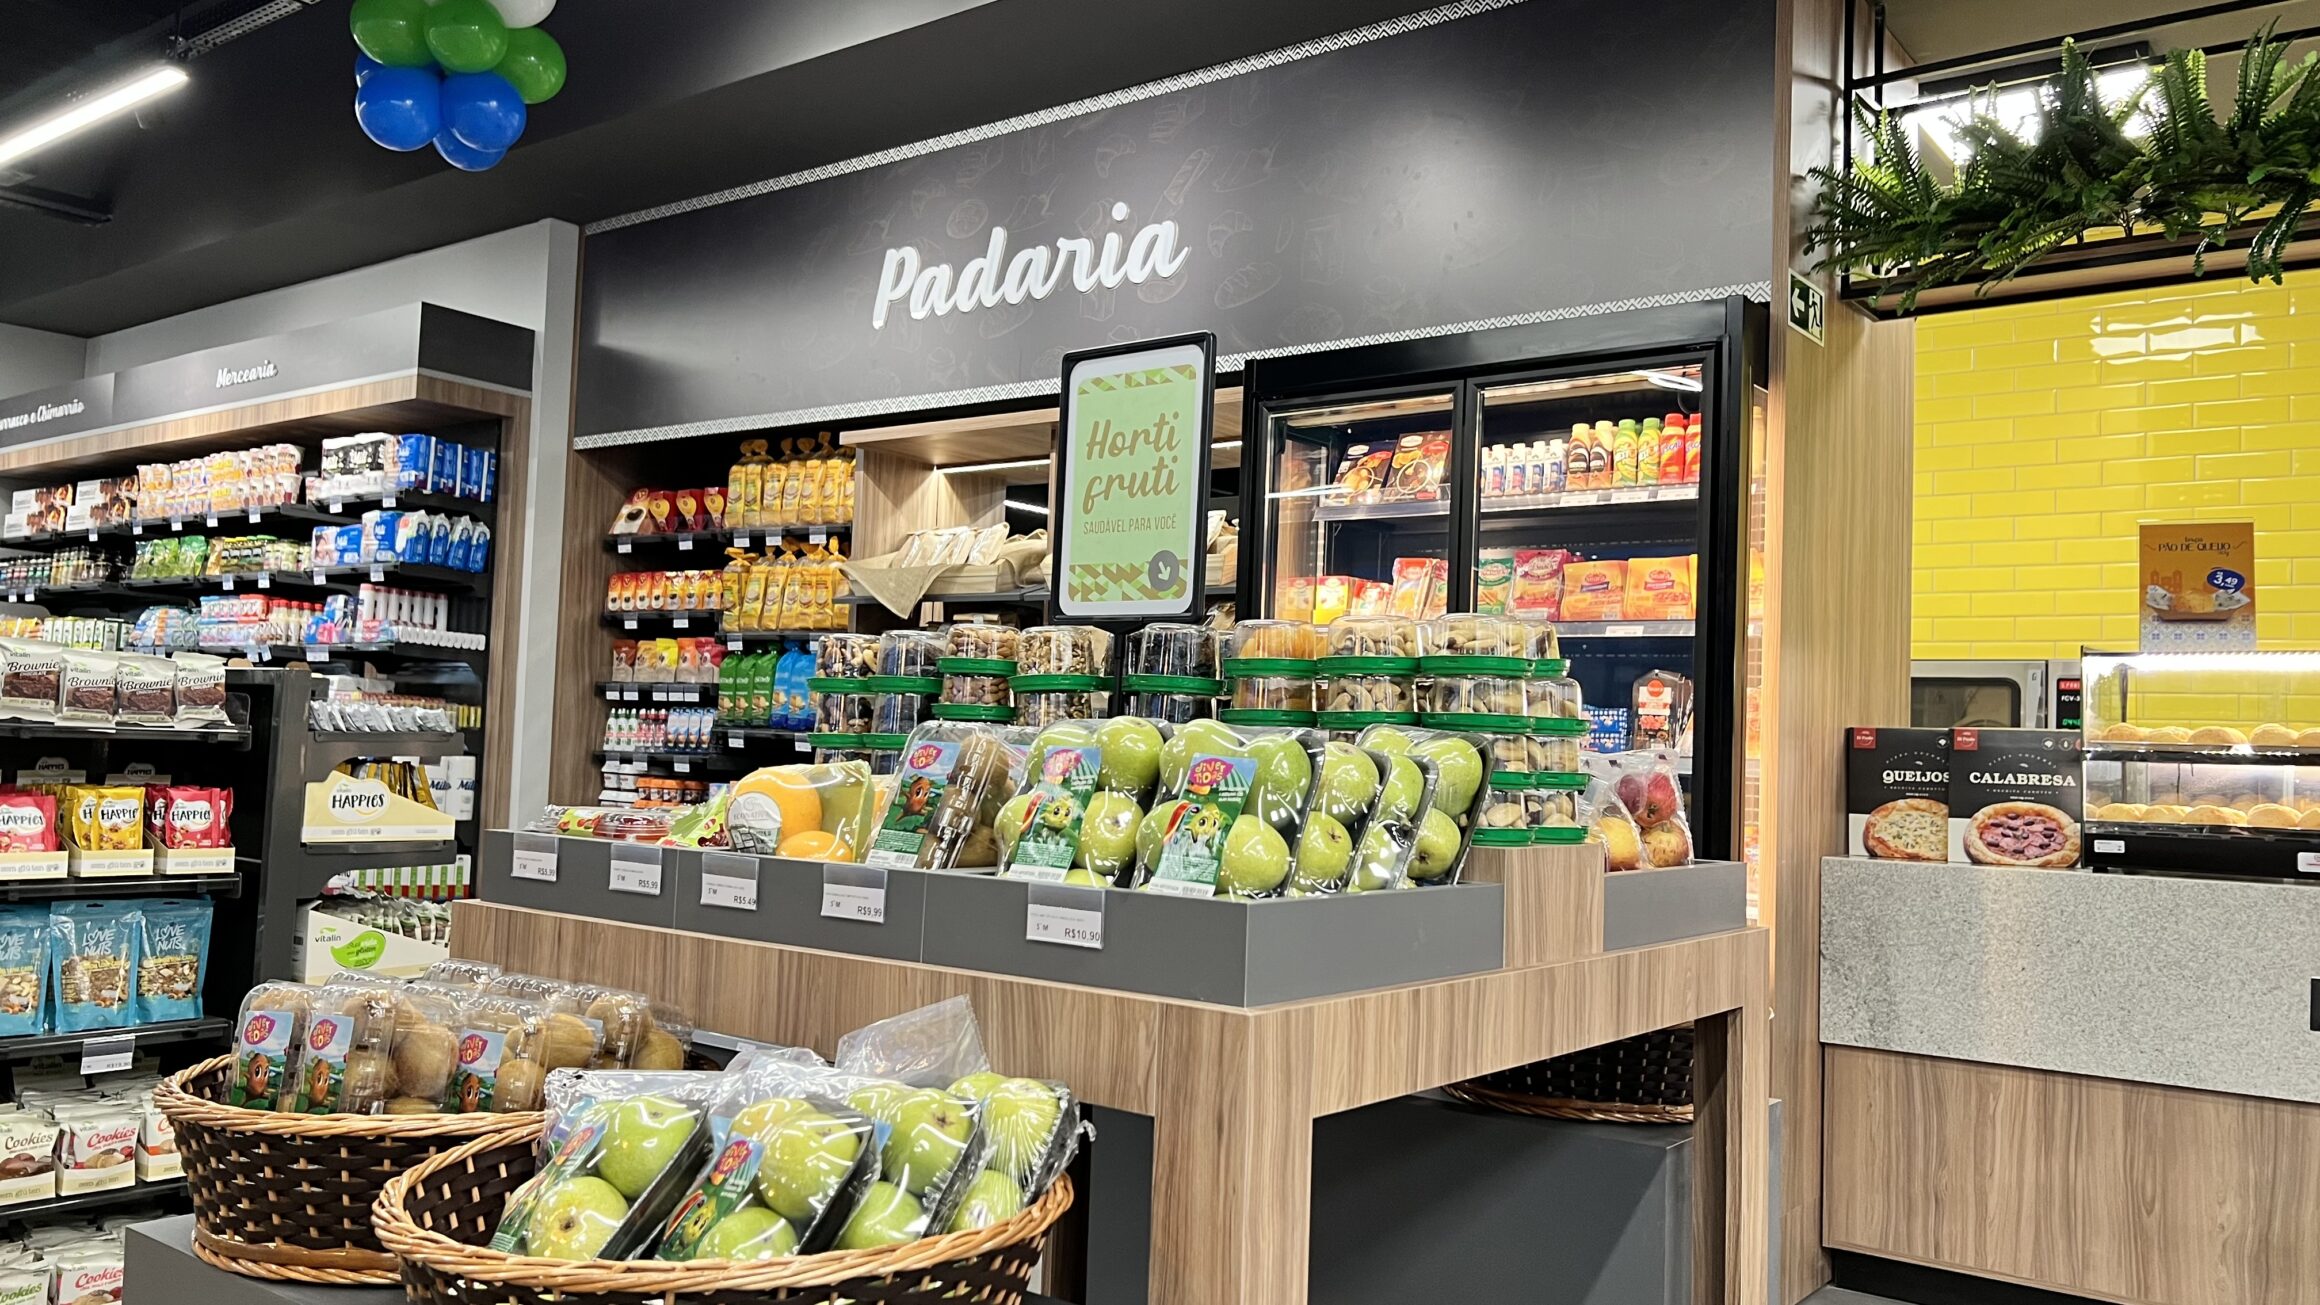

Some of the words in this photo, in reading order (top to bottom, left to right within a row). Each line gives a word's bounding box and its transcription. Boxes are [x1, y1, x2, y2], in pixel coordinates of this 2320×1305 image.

[872, 201, 1192, 330] Padaria
[216, 359, 277, 388] Mercearia
[30, 411, 37, 424] e
[37, 398, 85, 423] Chimarrão
[1086, 411, 1181, 460] Horti
[1082, 455, 1179, 515] fruti
[1083, 517, 1128, 535] SAUDÁVEL
[1128, 516, 1151, 532] PARA
[1154, 512, 1177, 531] VOCÊ
[2158, 542, 2178, 552] PÃO
[2180, 543, 2193, 552] DE
[2196, 542, 2231, 552] QUEIJO
[2213, 575, 2238, 587] 3,49
[7, 658, 60, 672] Brownie
[123, 676, 173, 691] Brownie
[178, 671, 226, 687] Brownie
[1882, 769, 1949, 784] QUEIJOS
[1969, 771, 2076, 787] CALABRESA
[331, 793, 385, 809] HAPPIES
[82, 928, 117, 947] LOVE
[155, 924, 187, 942] LOVE
[314, 934, 342, 943] vitalin
[1064, 927, 1101, 942] R$10,90
[84, 940, 113, 957] NUTS
[157, 935, 182, 951] NUTS
[5, 1131, 54, 1150] Cookies
[87, 1126, 136, 1148] Cookies
